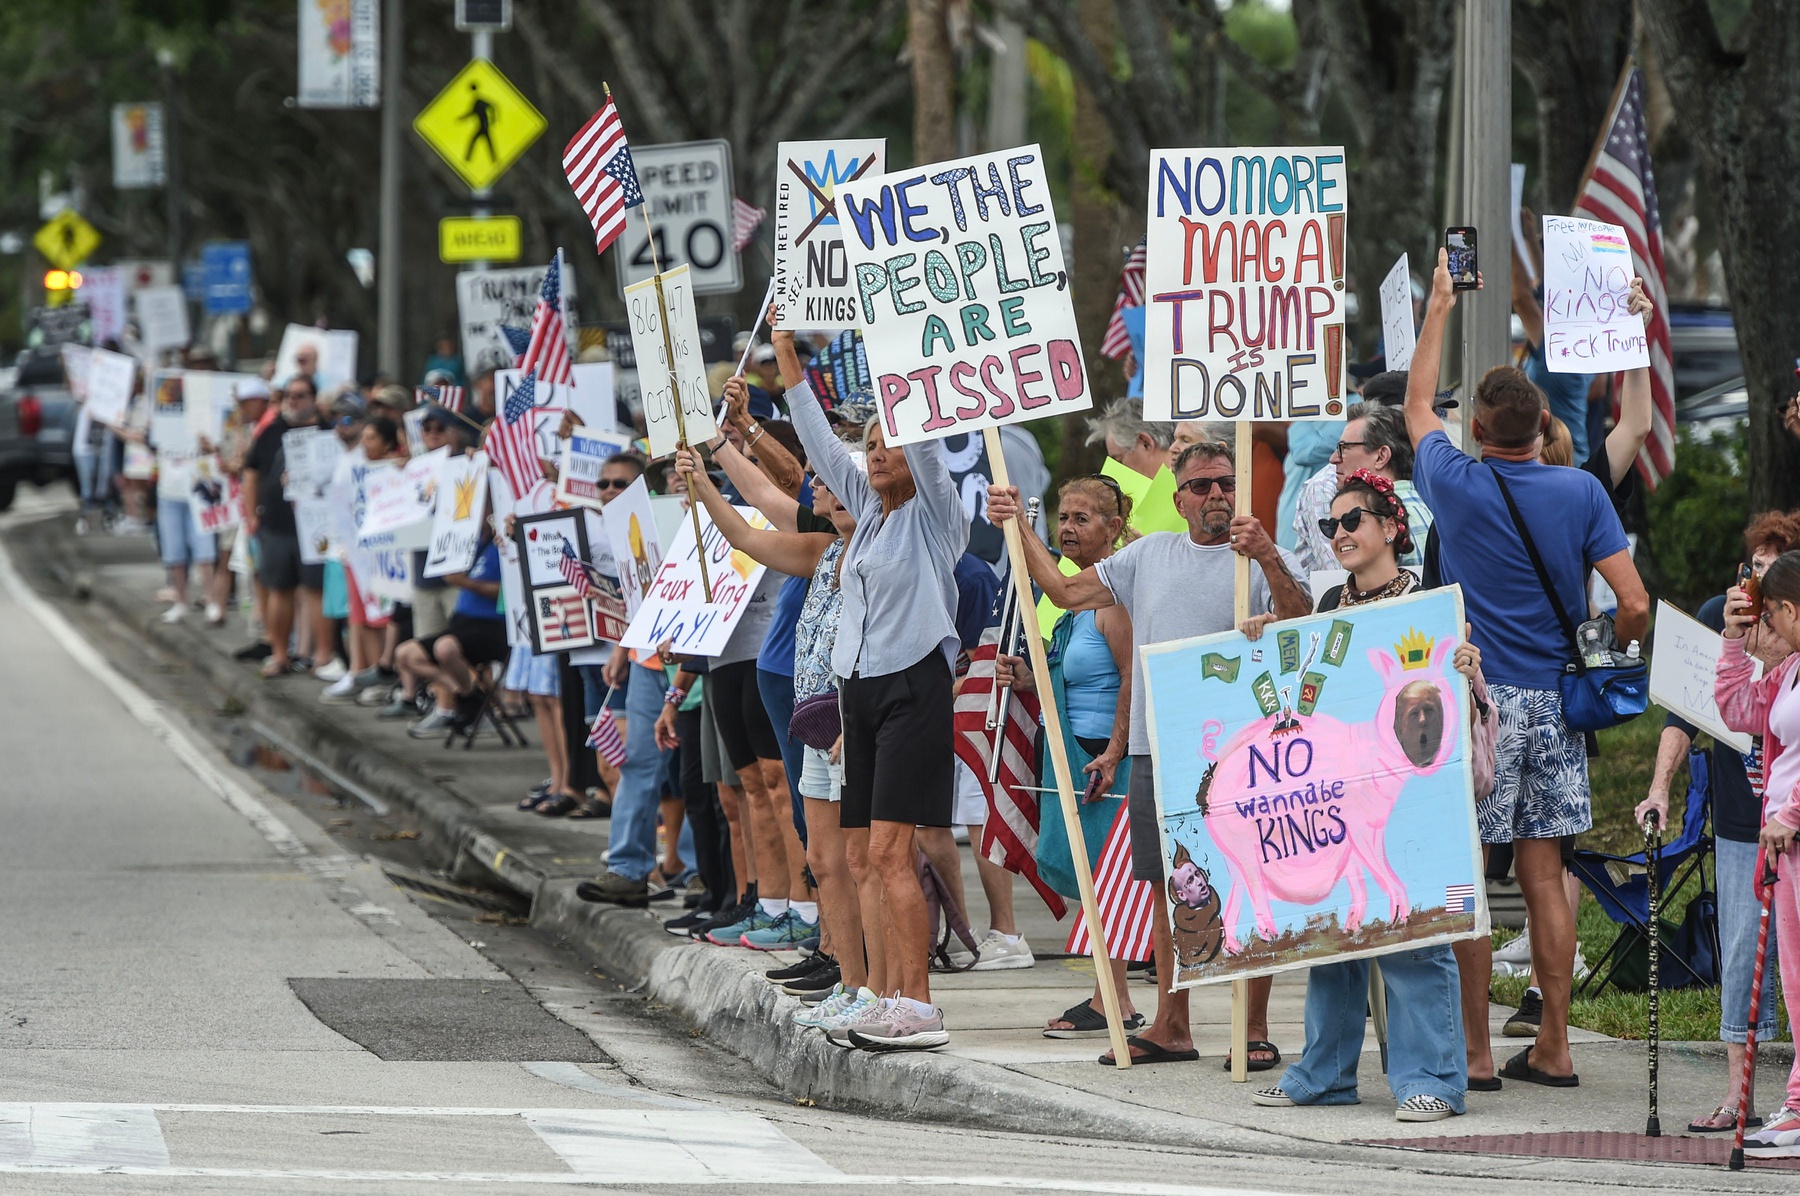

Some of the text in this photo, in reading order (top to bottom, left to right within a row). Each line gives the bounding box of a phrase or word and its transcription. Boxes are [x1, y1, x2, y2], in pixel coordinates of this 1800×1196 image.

[640, 160, 720, 190] PEED
[1157, 155, 1344, 218] NO MORE
[635, 191, 711, 219] LIMIT
[843, 154, 1045, 251] WE, THE
[453, 230, 506, 249] AHEAD
[630, 220, 725, 272] 40
[1547, 218, 1576, 234] Free
[776, 182, 790, 322] US NAVY RETIRED
[806, 239, 849, 289] NO
[854, 221, 1067, 324] PEOPLE,
[1584, 265, 1629, 294] NO
[632, 296, 657, 335] 86
[805, 296, 857, 322] KINGS
[921, 296, 1033, 358] ARE
[1152, 285, 1336, 355] TRUMP
[833, 358, 847, 400] LANDS
[844, 352, 858, 393] BOOKS
[855, 341, 869, 386] SOCIAL
[1170, 322, 1345, 420] DONE!
[1226, 347, 1265, 375] IS
[646, 375, 708, 424] CIRCUS
[877, 339, 1085, 438] PISSED
[686, 520, 732, 565] NO
[648, 563, 695, 602] Faux
[704, 571, 749, 622] King
[1282, 635, 1296, 671] META
[1673, 634, 1689, 650] In
[1257, 679, 1277, 713] KKK
[1246, 737, 1314, 789] NO
[1234, 778, 1346, 819] wannabe
[1255, 804, 1347, 864] KINGS
